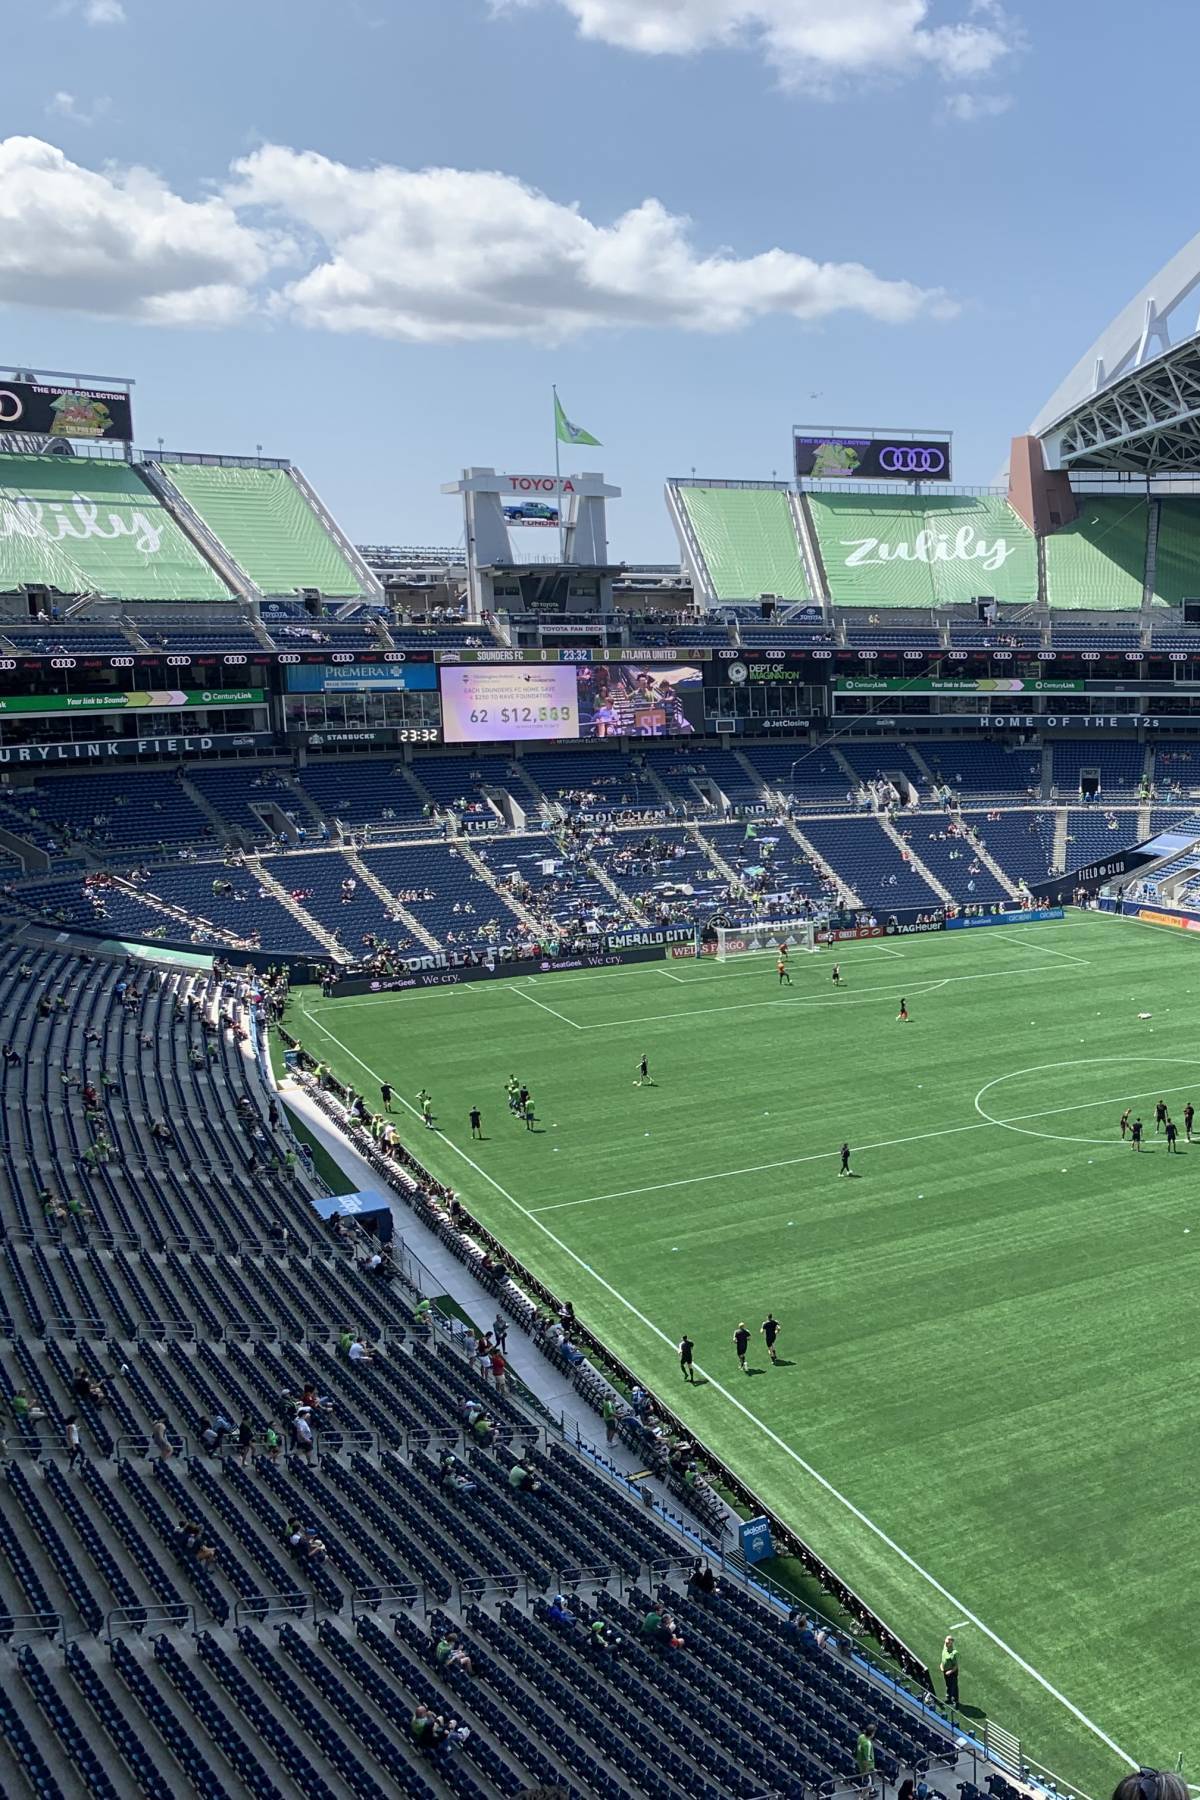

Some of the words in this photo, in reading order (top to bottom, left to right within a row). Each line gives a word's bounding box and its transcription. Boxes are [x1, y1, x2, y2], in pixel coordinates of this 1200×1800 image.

[32, 386, 49, 394] THE
[51, 388, 72, 396] RAVE
[74, 390, 125, 401] COLLECTION
[840, 525, 1016, 570] zulily
[477, 650, 514, 660] SOUNDERS
[515, 650, 524, 660] FC
[541, 650, 547, 660] 0
[563, 650, 587, 660] 23:32
[604, 651, 610, 660] 0
[621, 651, 651, 659] ATLANTA
[652, 651, 677, 659] UNITED
[325, 666, 384, 677] PREMERA
[749, 664, 770, 672] DEPT
[772, 664, 784, 672] OF
[750, 671, 800, 680] IMAGINATION
[66, 698, 82, 706] Your
[82, 697, 96, 705] link
[212, 692, 252, 701] CenturyLink
[470, 709, 488, 723] 62
[770, 719, 810, 728] JetClosing
[980, 718, 1034, 727] HOME
[1047, 718, 1070, 727] OF
[1084, 718, 1118, 727] THE
[1132, 718, 1160, 727] 12s
[326, 733, 375, 741] STARBUCKS
[401, 730, 438, 742] 23:32
[138, 738, 213, 753] FIELD
[467, 820, 498, 831] THE
[1079, 866, 1098, 881] FIELD
[1107, 861, 1125, 879] CLUB
[608, 933, 663, 948] EMERALD
[666, 928, 694, 941] CITY
[674, 945, 708, 956] WELS
[552, 960, 582, 970] SeatGeek
[587, 957, 606, 965] We
[608, 955, 623, 966] cry.
[422, 975, 439, 984] We
[441, 974, 460, 985] cry.
